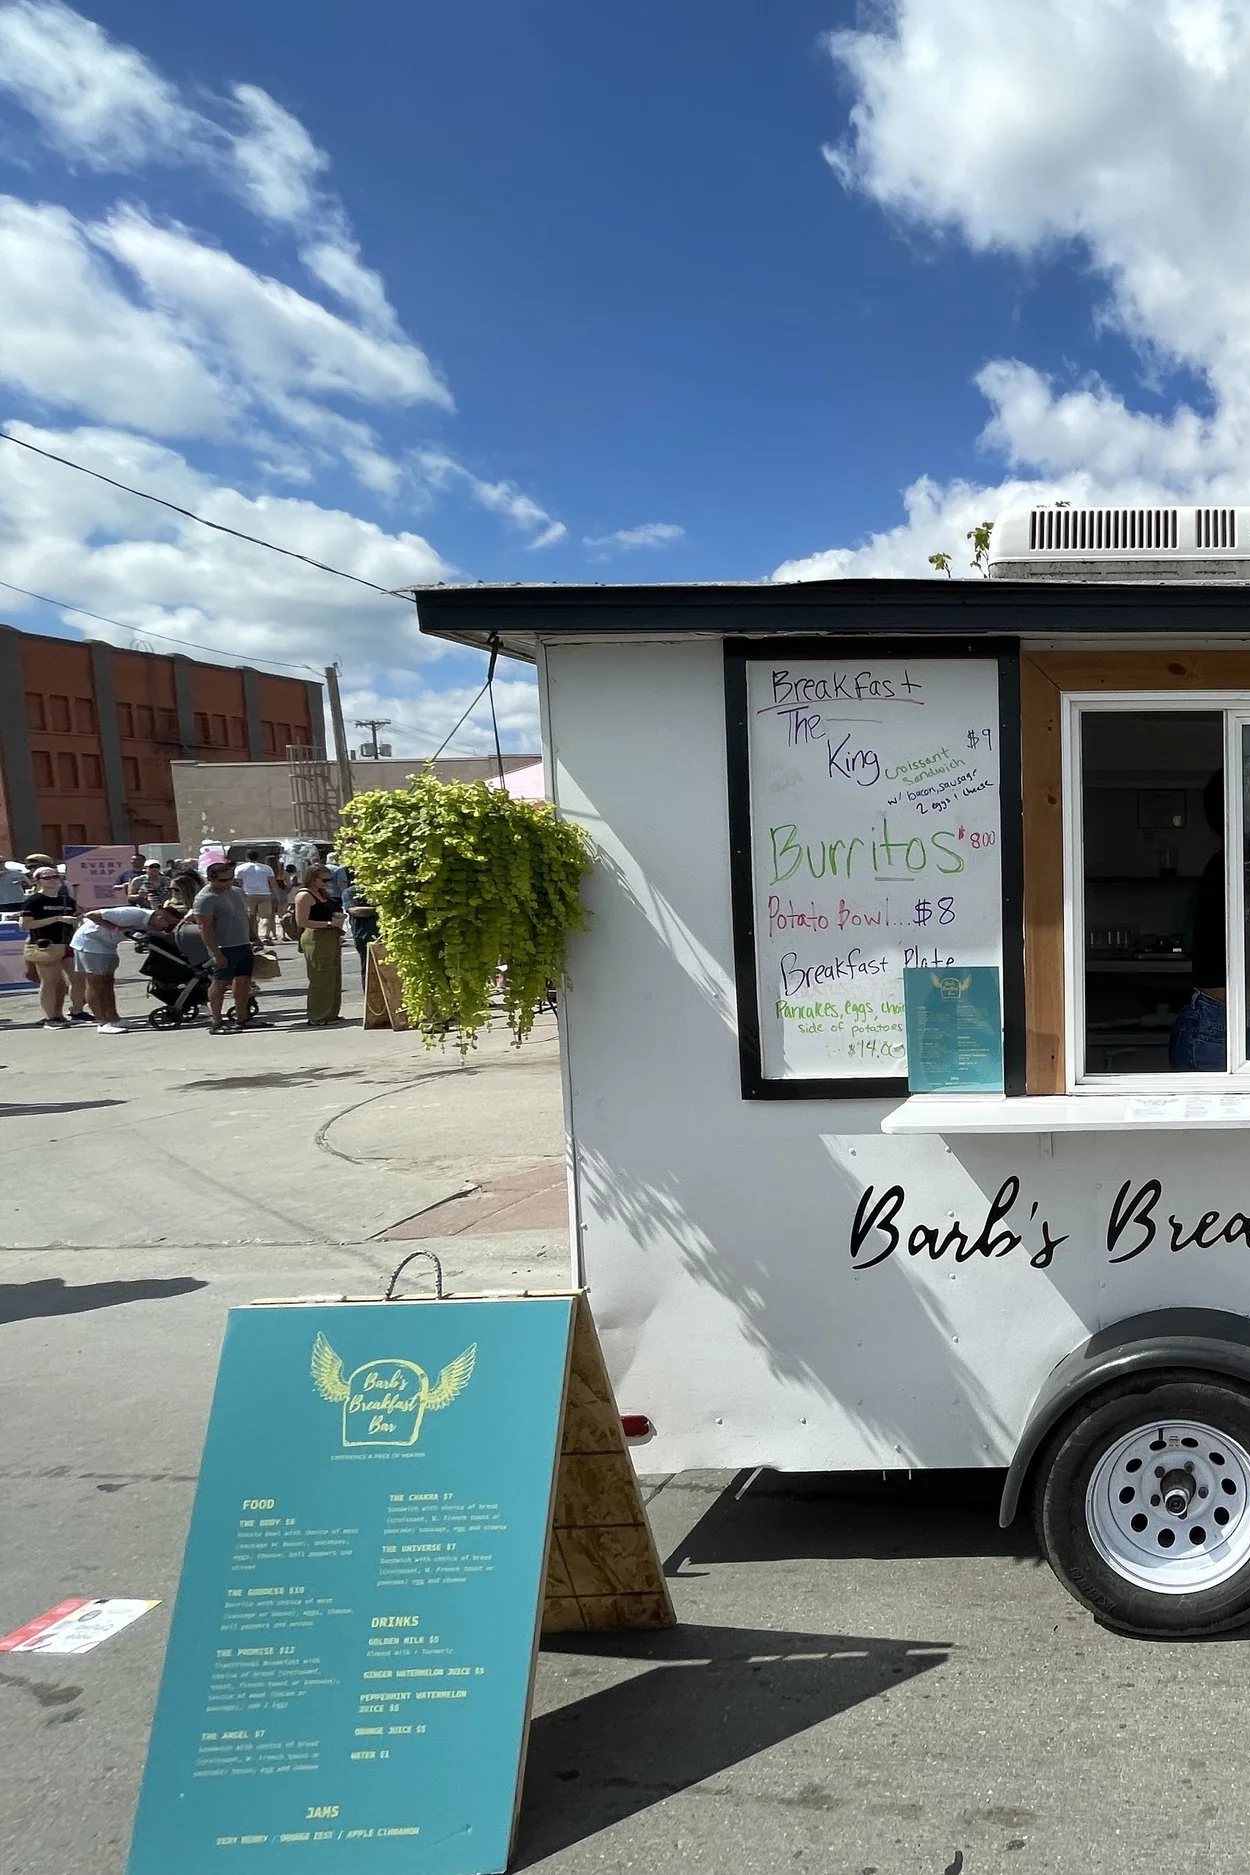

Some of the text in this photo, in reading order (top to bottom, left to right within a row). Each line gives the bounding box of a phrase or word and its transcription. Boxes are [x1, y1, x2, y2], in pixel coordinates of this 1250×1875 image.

[777, 706, 826, 746] The
[827, 734, 880, 786] King
[916, 803, 928, 814] 2
[768, 896, 828, 937] Potato
[780, 948, 889, 996] Breakfast
[798, 1022, 903, 1037] side of potatoes
[851, 1176, 1069, 1269] Barb's
[363, 1369, 408, 1392] Barb's
[349, 1392, 420, 1414] Breakfast
[368, 1415, 397, 1434] Bar
[389, 1494, 404, 1502] THE
[243, 1499, 275, 1510] FOOD
[382, 1545, 396, 1553] THE
[402, 1544, 441, 1552] UNIVERSE
[371, 1616, 419, 1628] DRINKS
[368, 1638, 399, 1646] GOLDEN
[404, 1636, 424, 1644] MILK
[363, 1670, 392, 1679] GINGER
[396, 1668, 444, 1677] WATERMELON
[447, 1667, 470, 1675] JUICE
[416, 1690, 467, 1699] WATERMELON
[359, 1705, 384, 1713] JUICE
[388, 1726, 412, 1734] JUICE
[351, 1751, 375, 1760] WATER
[306, 1806, 339, 1819] JAMS
[346, 1829, 373, 1838] APPLE
